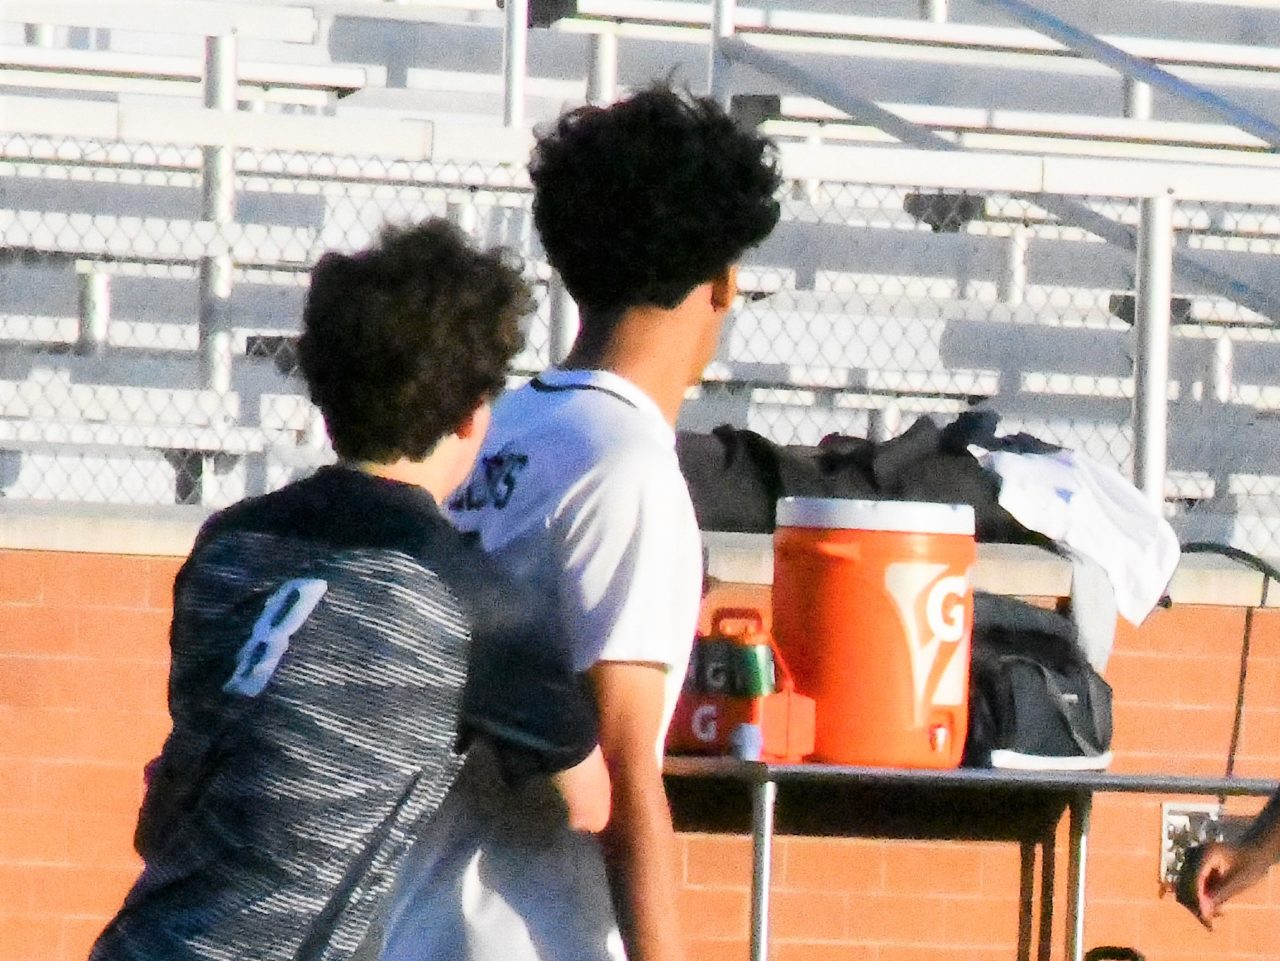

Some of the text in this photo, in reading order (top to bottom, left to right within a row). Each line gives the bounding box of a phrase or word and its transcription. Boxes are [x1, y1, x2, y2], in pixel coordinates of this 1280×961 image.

[223, 578, 328, 697] 8
[926, 576, 965, 642] G
[691, 704, 718, 742] G
